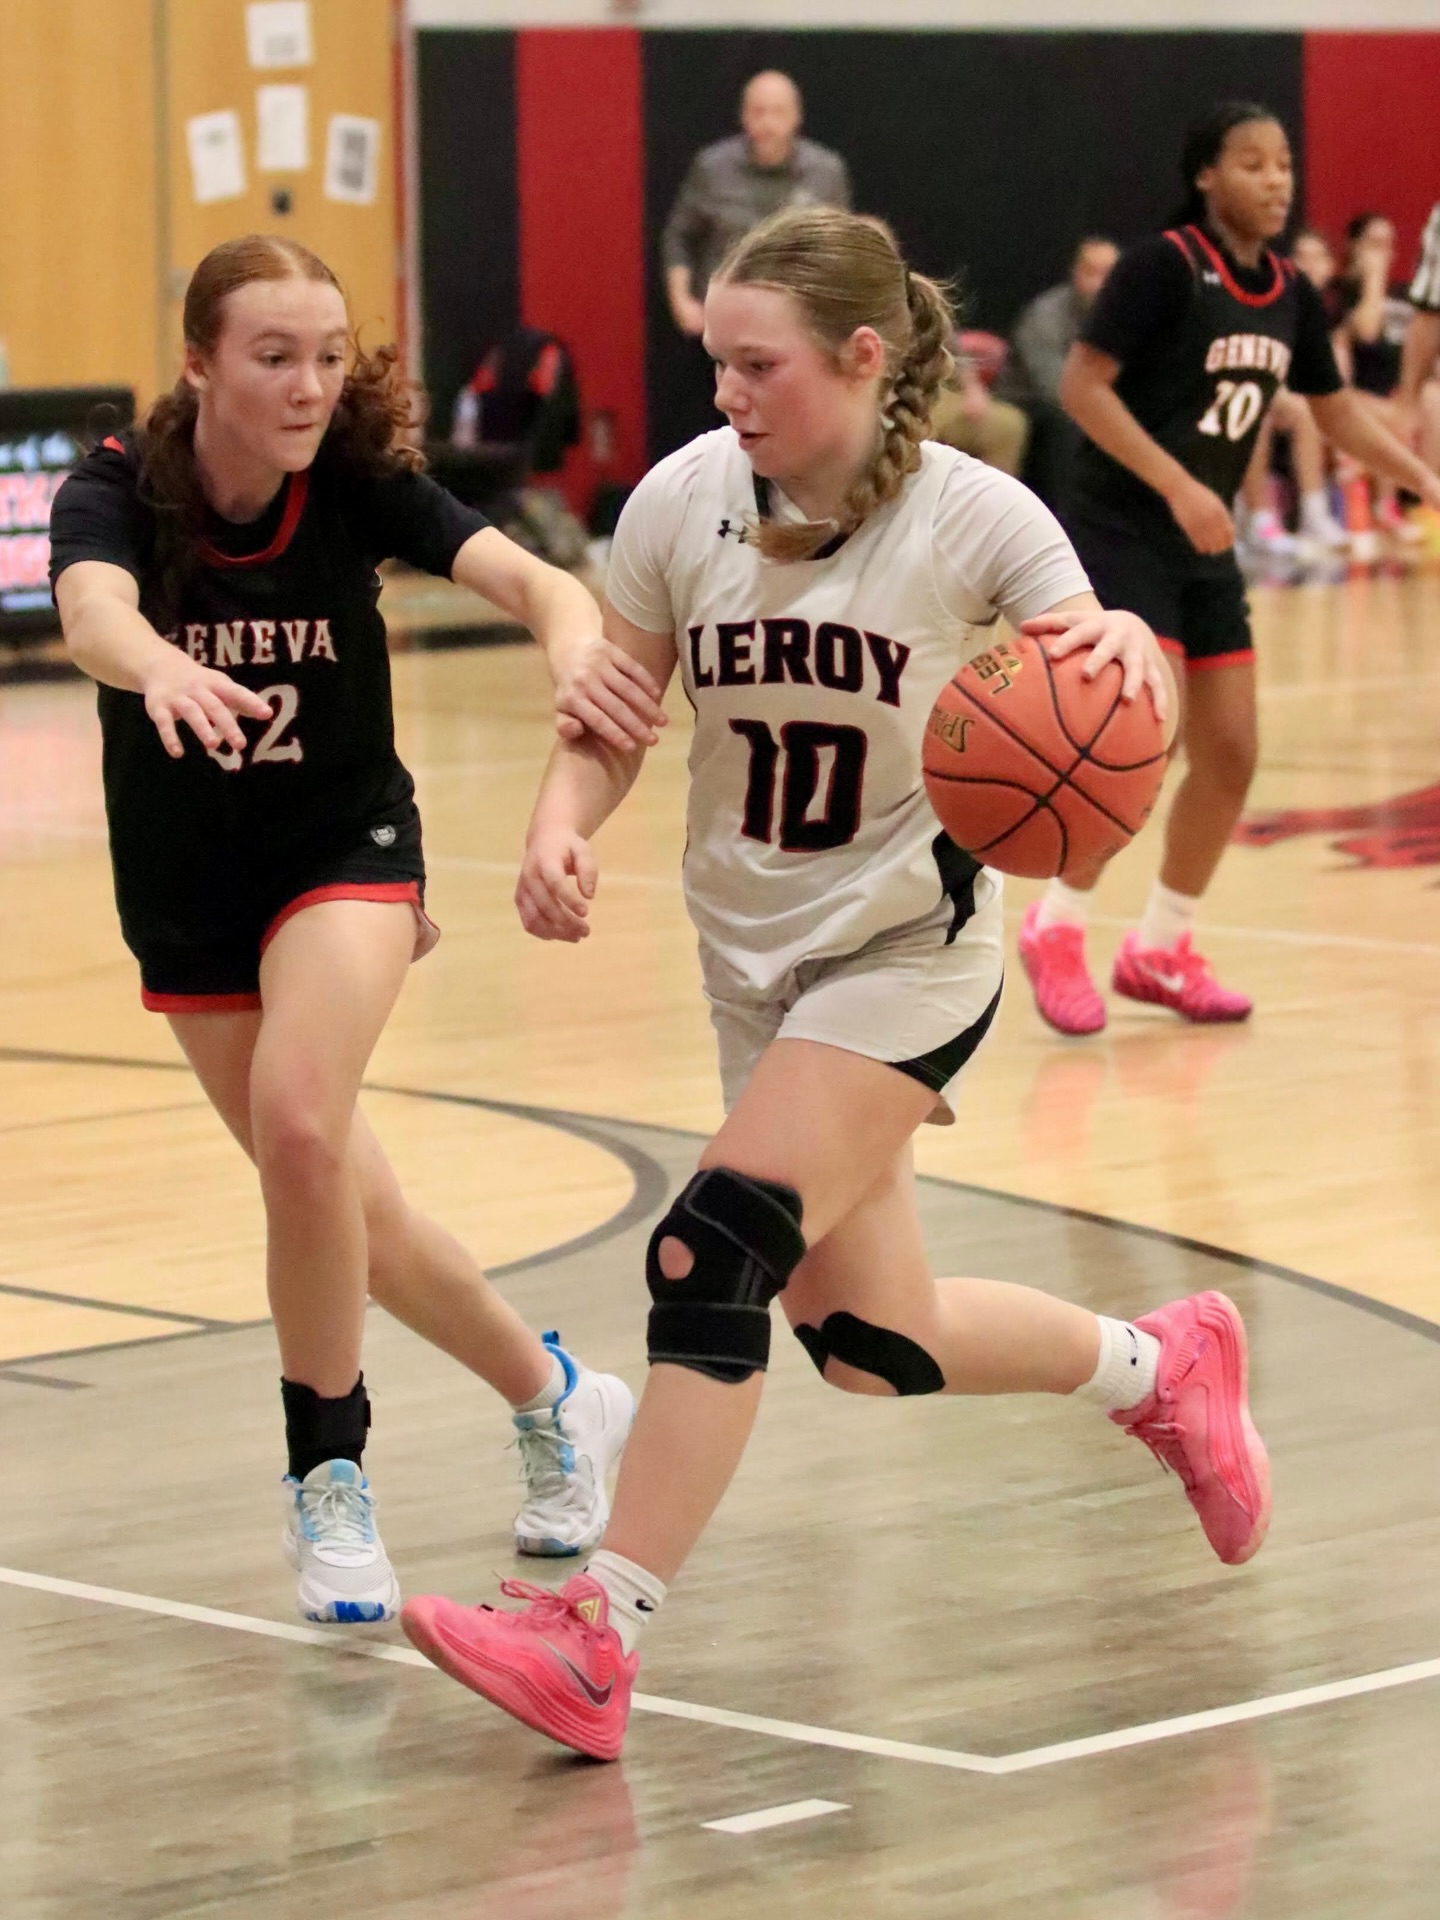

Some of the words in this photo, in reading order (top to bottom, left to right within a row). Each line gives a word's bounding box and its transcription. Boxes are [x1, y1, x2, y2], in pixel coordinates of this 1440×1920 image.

[165, 618, 338, 667] ENEVA
[688, 617, 911, 708] LEROY
[727, 717, 868, 853] 10
